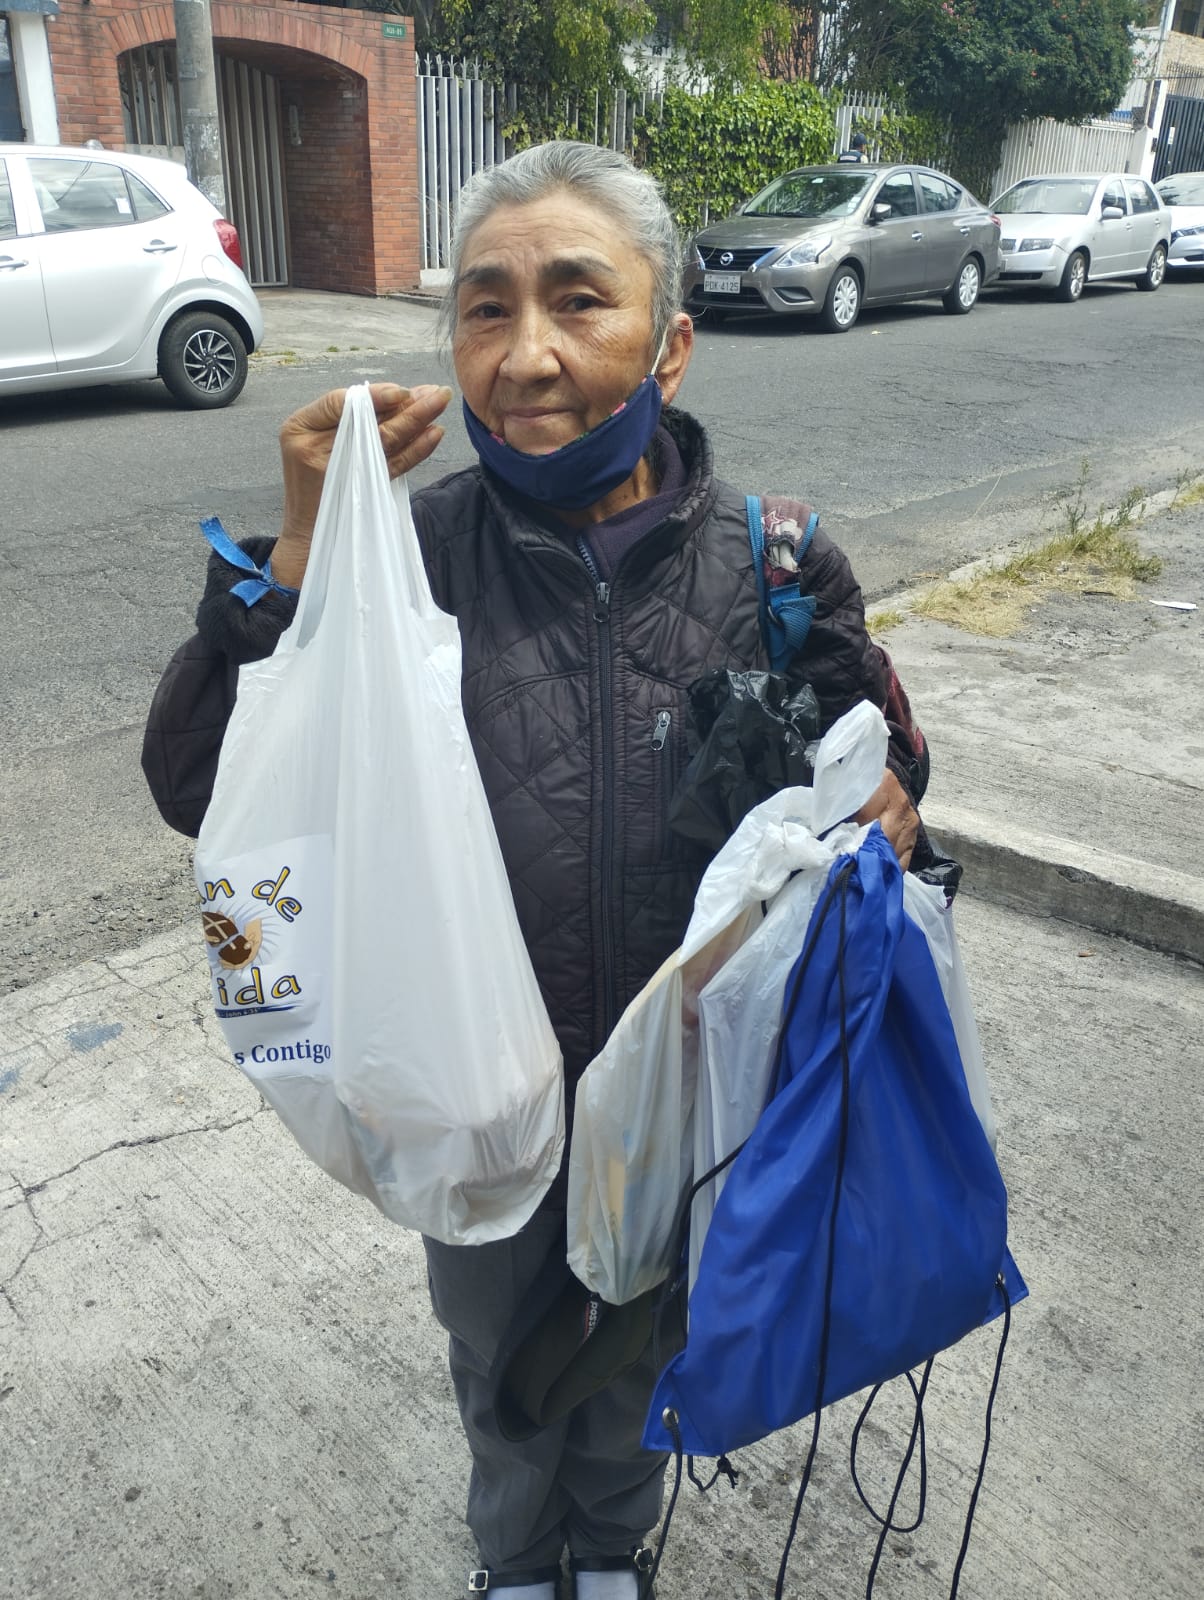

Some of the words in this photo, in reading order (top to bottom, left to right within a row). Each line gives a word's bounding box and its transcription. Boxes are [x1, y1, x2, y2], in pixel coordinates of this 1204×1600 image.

[201, 878, 235, 904] n
[251, 865, 302, 923] de
[216, 966, 302, 1006] ida
[233, 1050, 246, 1065] s
[251, 1039, 331, 1064] Contigo
